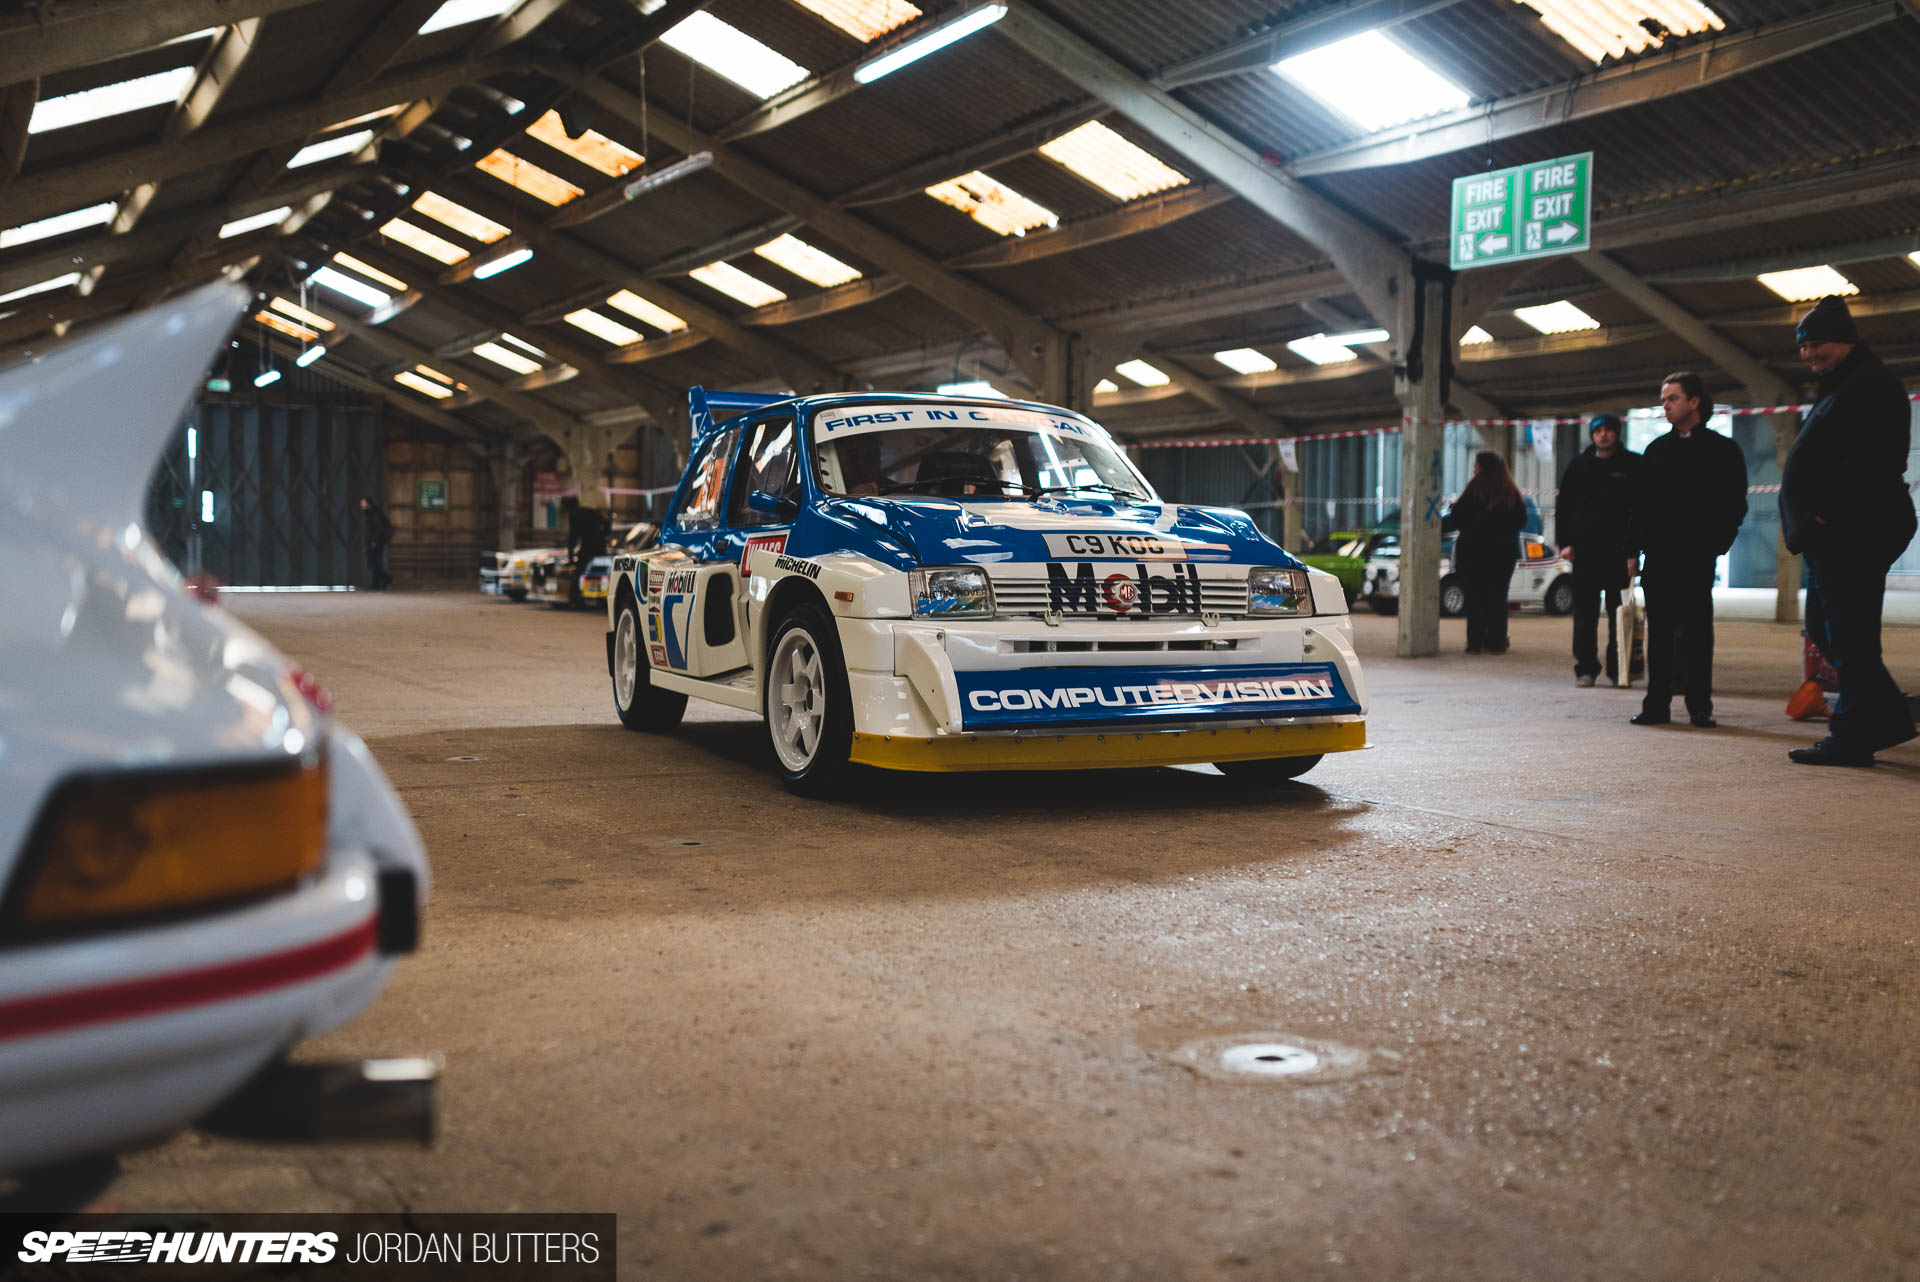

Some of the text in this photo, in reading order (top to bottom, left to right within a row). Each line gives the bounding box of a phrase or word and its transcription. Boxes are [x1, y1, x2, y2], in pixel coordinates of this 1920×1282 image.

[1466, 177, 1505, 204] FIRE
[1533, 163, 1577, 192] FIRE
[1466, 205, 1504, 231] EXIT
[1533, 192, 1574, 220] EXIT
[825, 410, 914, 432] FIRST
[926, 409, 959, 421] IN
[1065, 535, 1165, 555] C9 KOG
[774, 555, 822, 580] MICHELIN
[1046, 562, 1201, 614] Mobil
[1118, 584, 1136, 600] MG
[968, 679, 1335, 712] COMPUTERVISION
